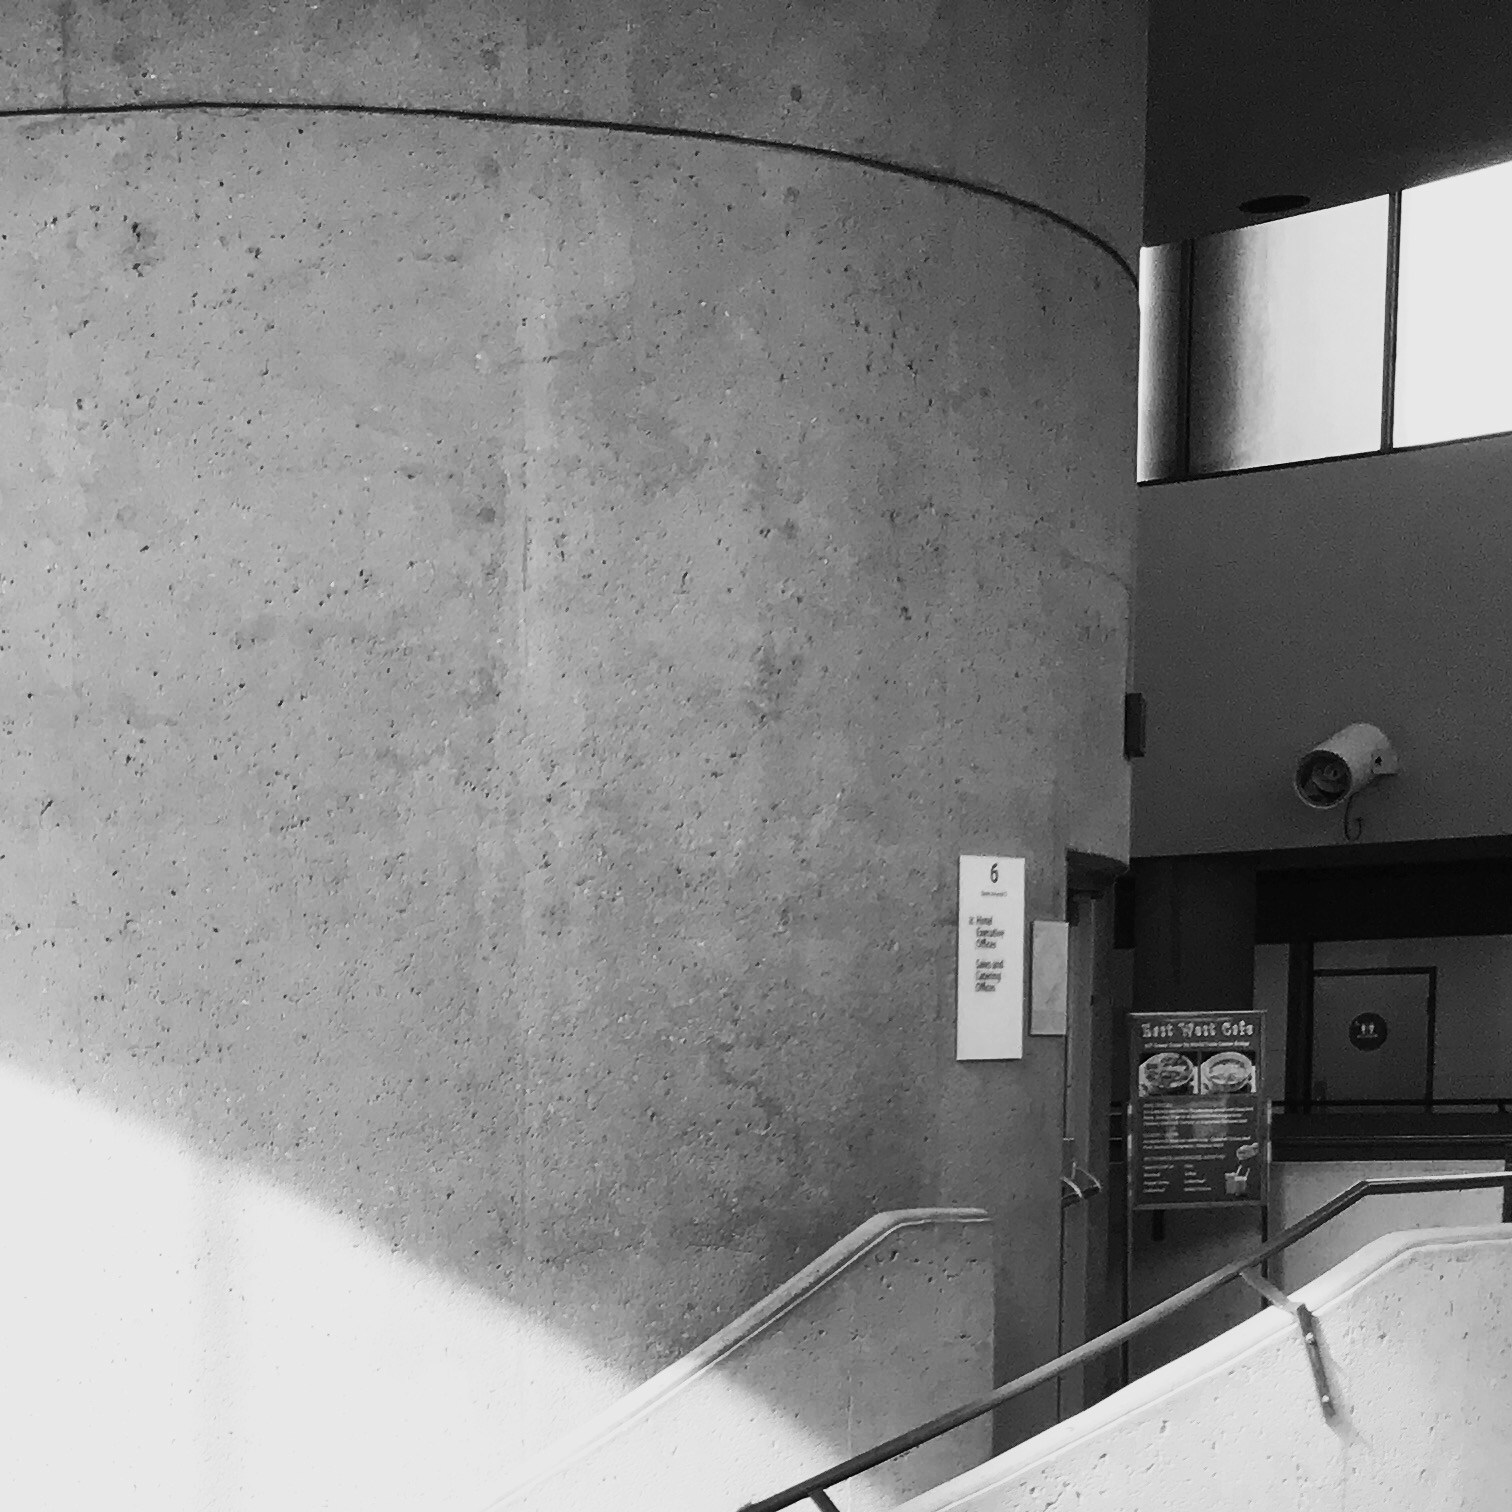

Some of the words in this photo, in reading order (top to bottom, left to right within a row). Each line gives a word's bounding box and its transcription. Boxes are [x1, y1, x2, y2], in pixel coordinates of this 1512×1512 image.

[990, 863, 999, 884] 6
[1141, 1022, 1174, 1037] East
[1177, 1022, 1216, 1037] West
